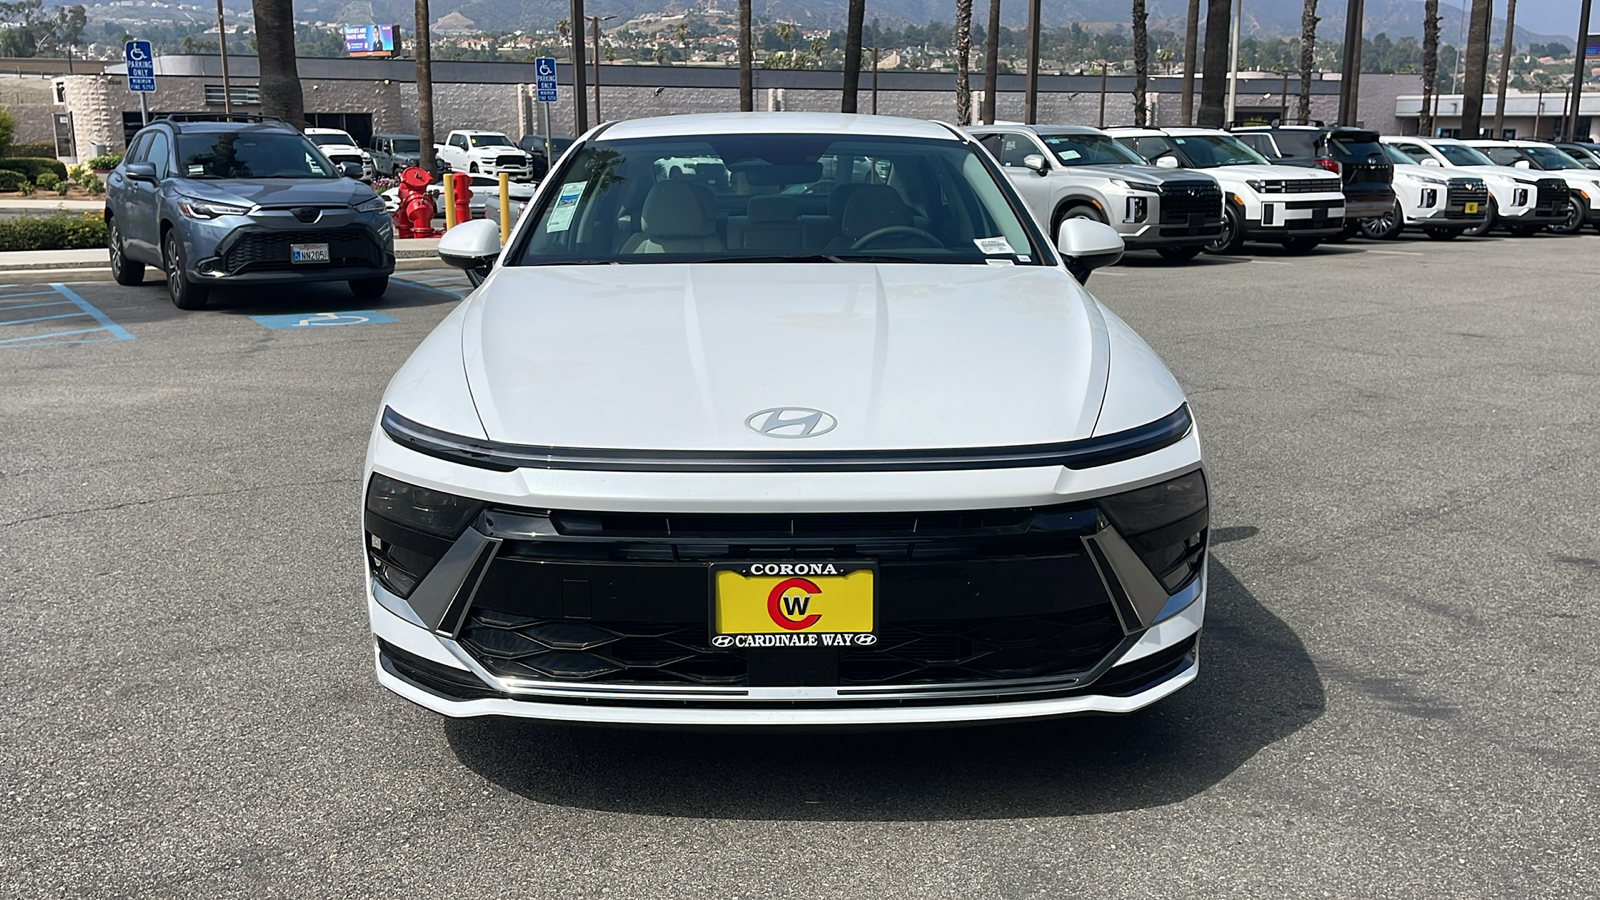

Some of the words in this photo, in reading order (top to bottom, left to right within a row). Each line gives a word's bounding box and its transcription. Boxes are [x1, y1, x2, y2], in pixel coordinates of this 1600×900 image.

[127, 60, 153, 69] PARKING
[132, 69, 149, 77] ONLY
[750, 563, 838, 576] CORONA
[735, 633, 818, 647] CARDINALE
[821, 633, 854, 646] WAY
